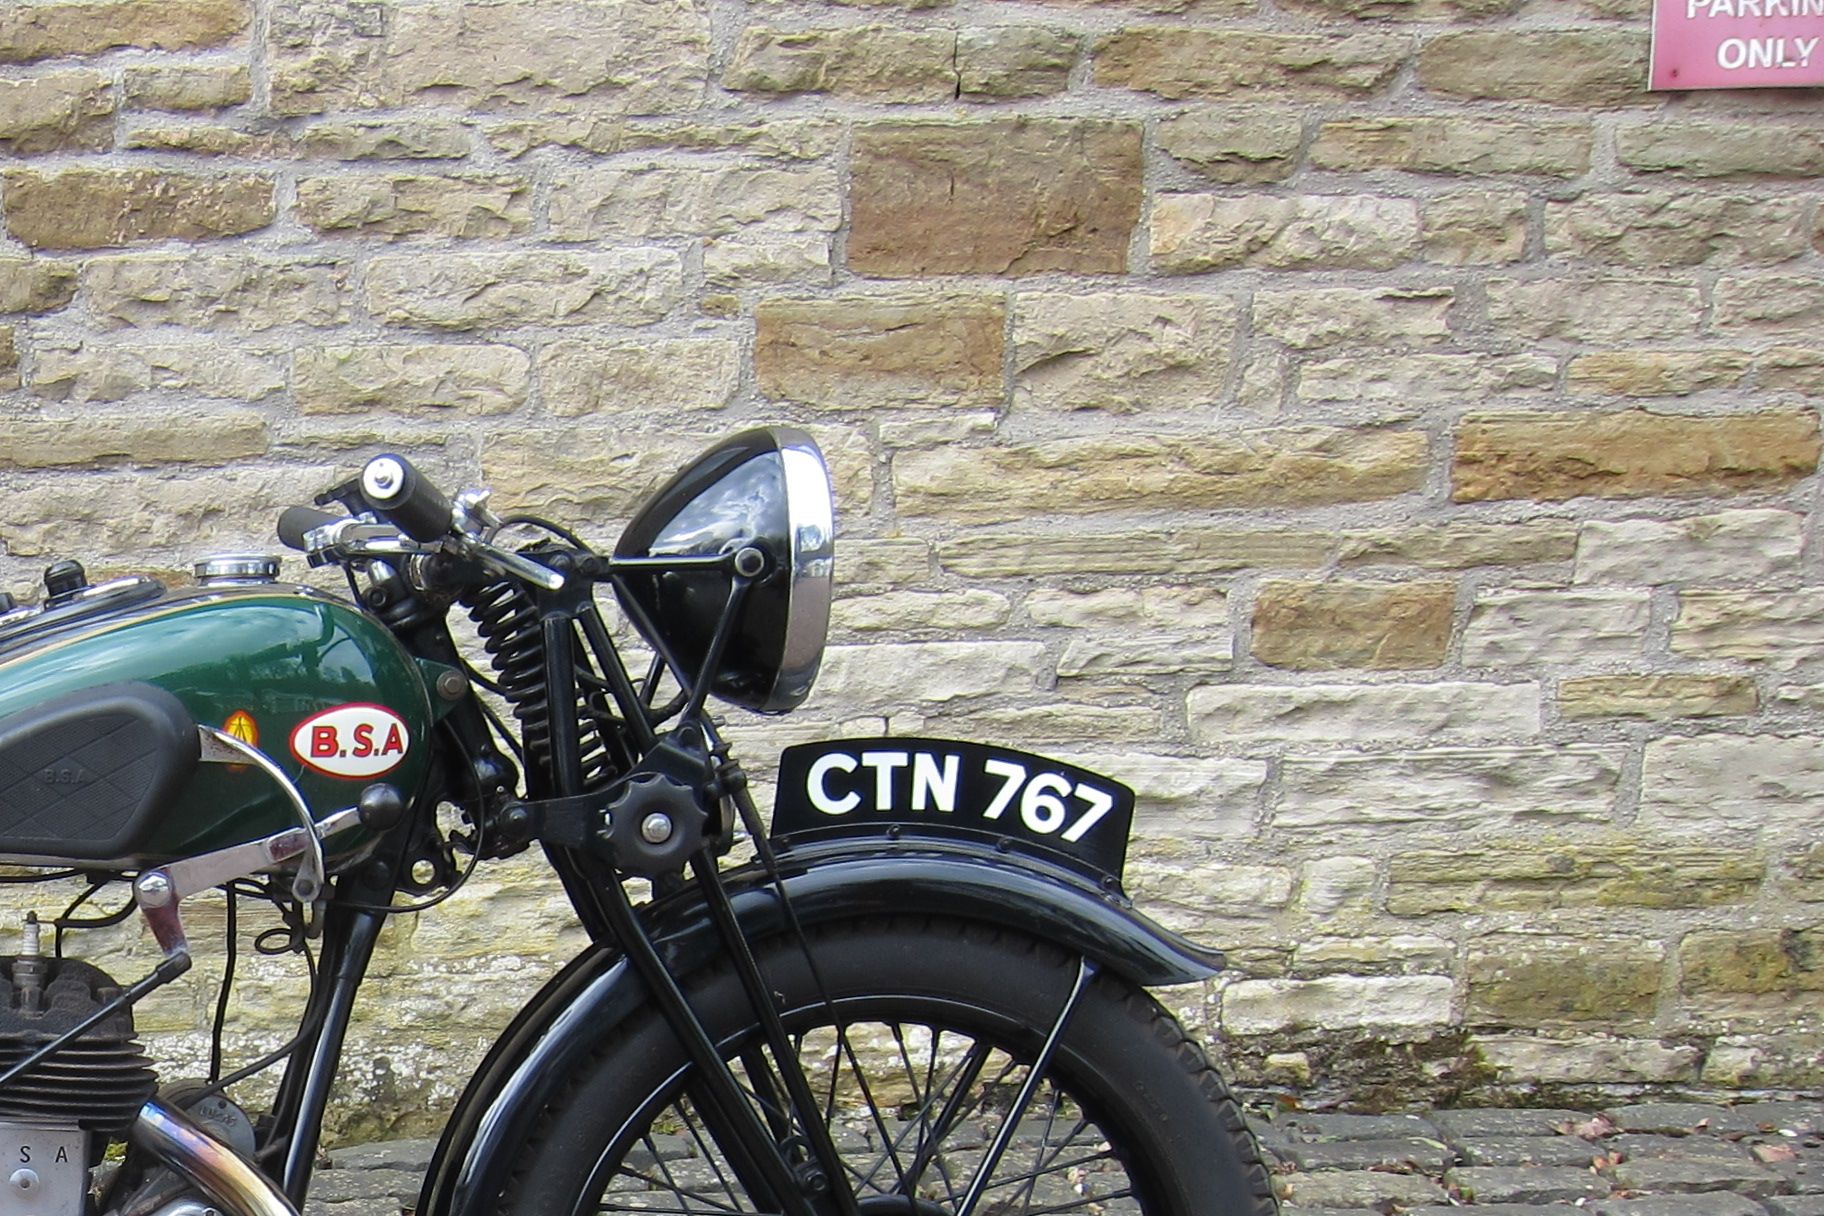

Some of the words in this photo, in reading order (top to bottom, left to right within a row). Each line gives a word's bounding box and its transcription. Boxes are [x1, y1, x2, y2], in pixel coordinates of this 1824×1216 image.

[1717, 38, 1820, 69] ONLY
[310, 722, 404, 758] B.S.A
[807, 751, 960, 815] CTN
[983, 759, 1113, 843] 767
